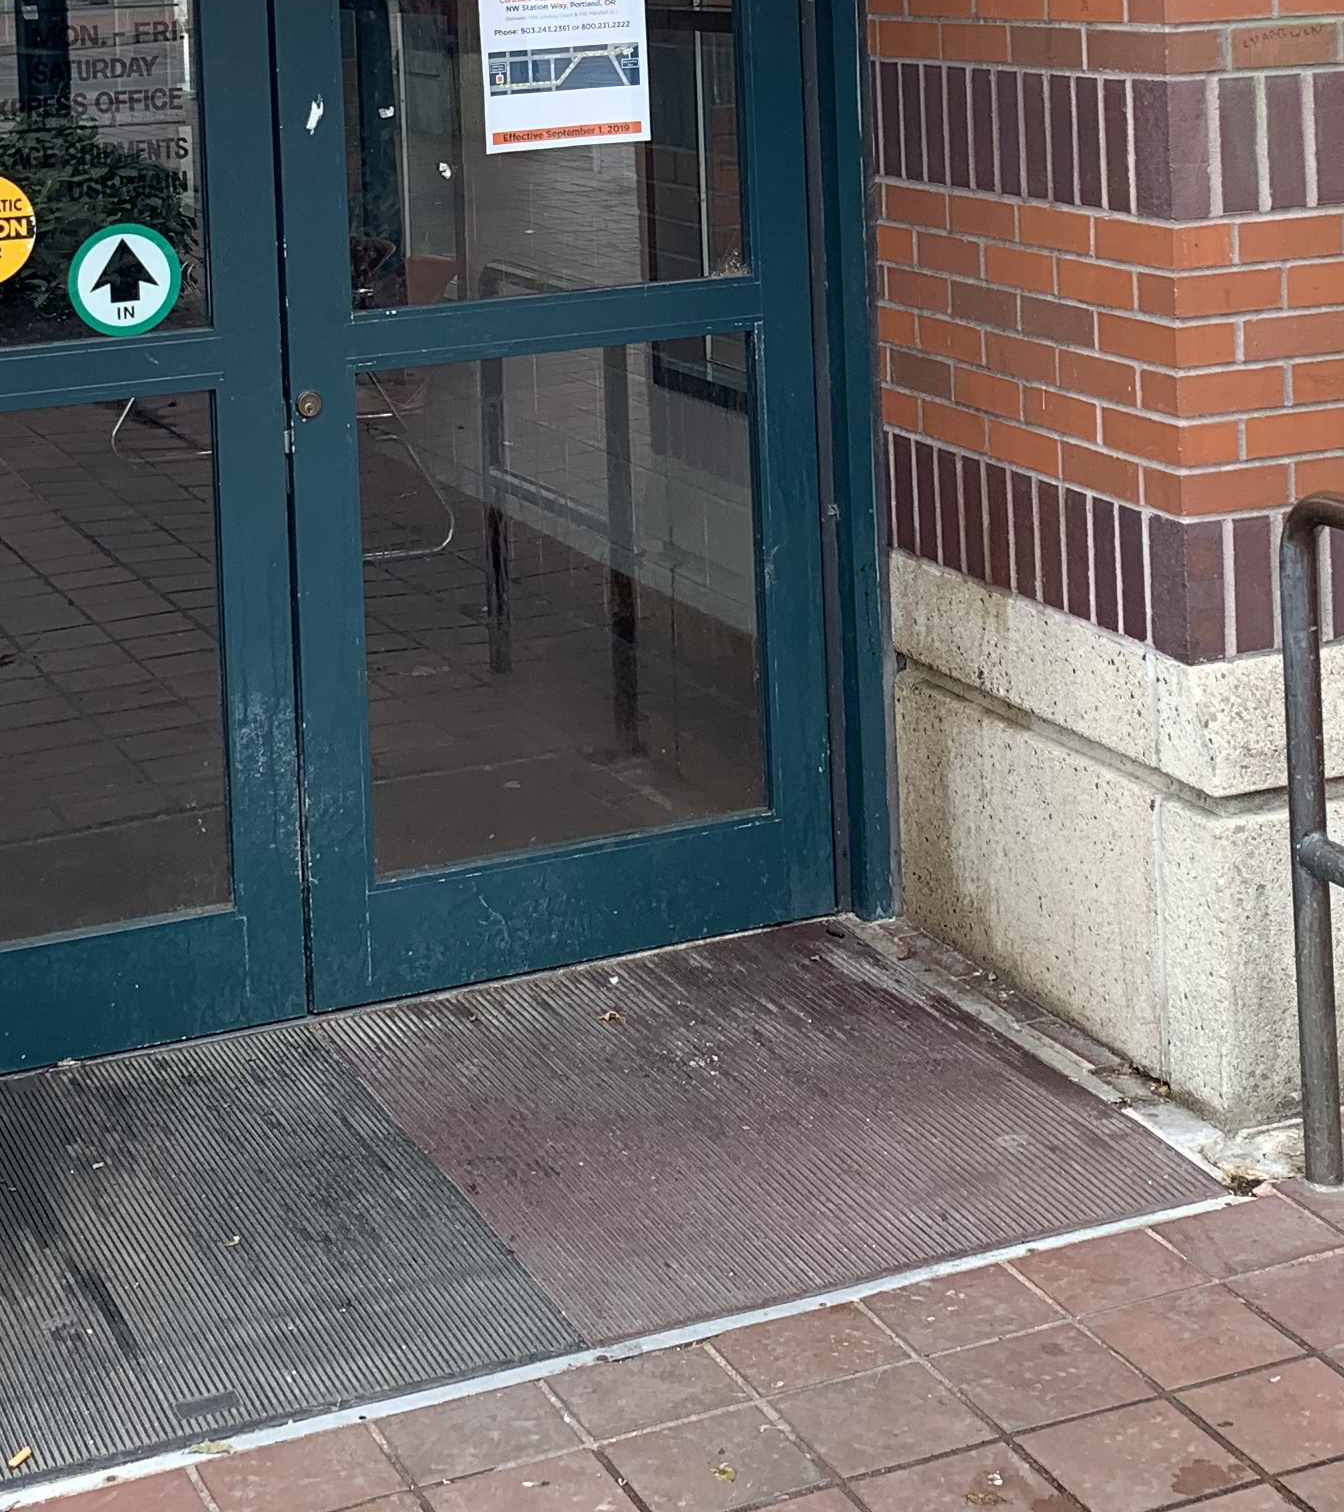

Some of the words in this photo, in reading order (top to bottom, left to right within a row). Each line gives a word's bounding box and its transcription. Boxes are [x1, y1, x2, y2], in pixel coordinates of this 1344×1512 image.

[551, 3, 568, 11] Way,
[570, 0, 602, 8] Portland,
[32, 24, 107, 47] MON.
[135, 21, 184, 44] FRI.
[494, 28, 518, 36] Phone:
[31, 56, 159, 84] SATURDAY
[94, 88, 184, 114] OFFICE
[503, 131, 543, 142] Effective
[546, 126, 595, 139] September
[607, 124, 630, 134] 2019
[117, 306, 135, 320] IN
